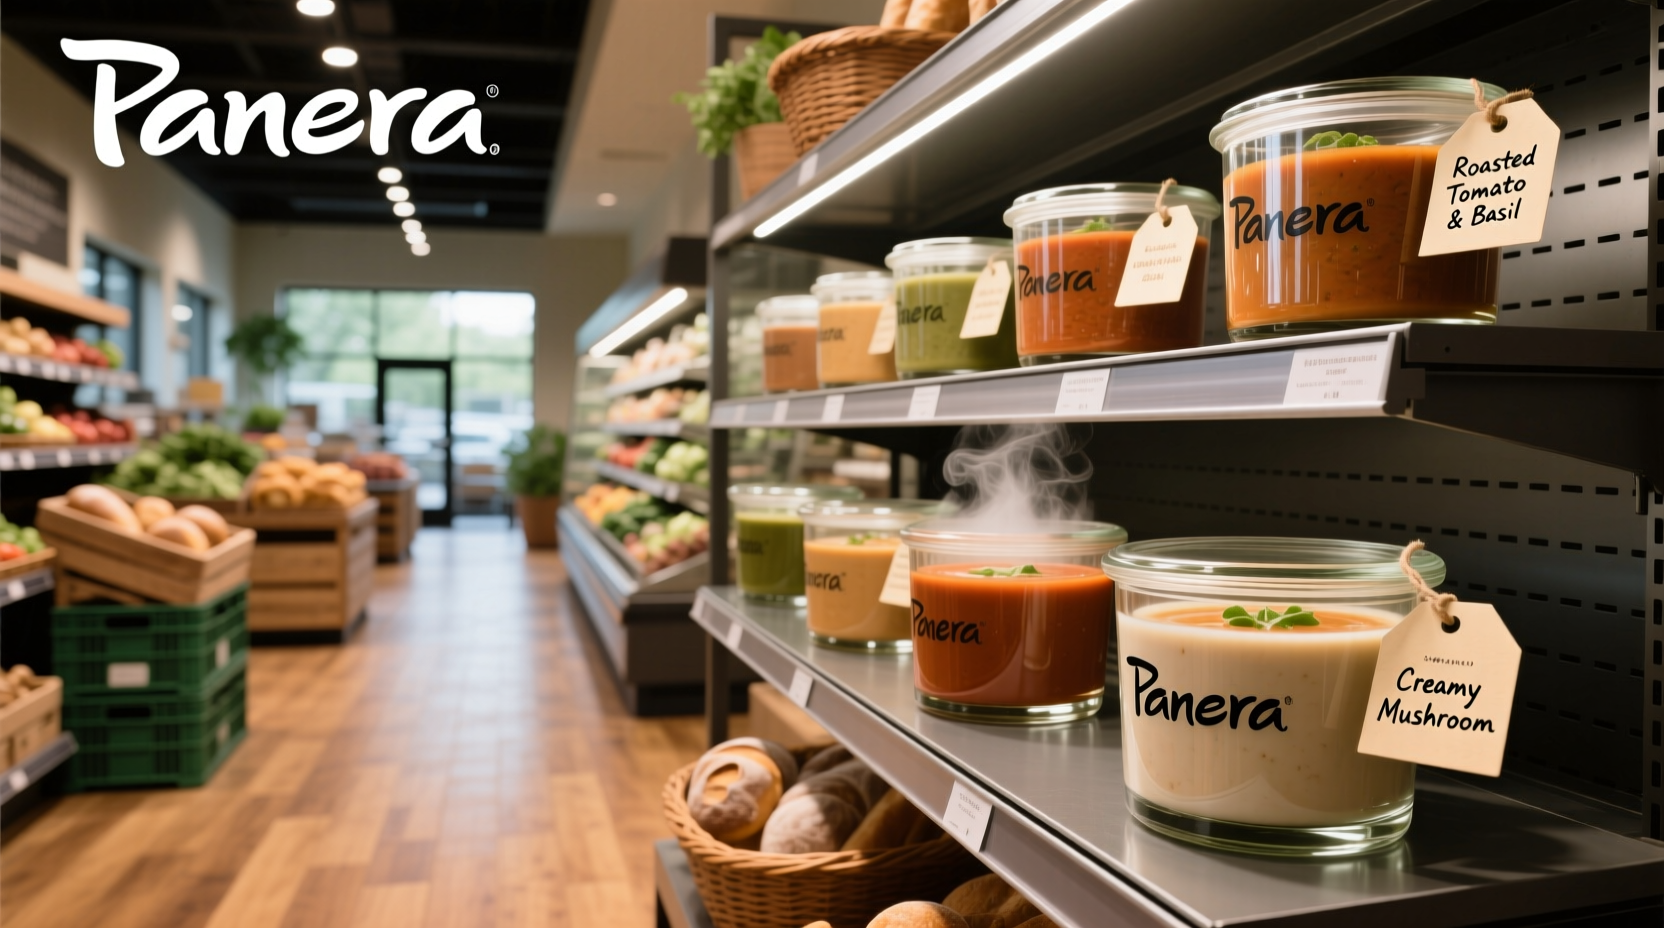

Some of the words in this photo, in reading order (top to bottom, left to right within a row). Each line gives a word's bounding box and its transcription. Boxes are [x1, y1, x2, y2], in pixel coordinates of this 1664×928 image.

[1453, 144, 1537, 178] Roasted
[1447, 175, 1526, 205] Tomato
[1230, 196, 1369, 249] Panera
[1447, 209, 1463, 229] &
[1471, 197, 1522, 226] Basil
[1127, 656, 1288, 732] Panera
[1397, 667, 1481, 709] Creamy
[1377, 698, 1495, 733] Mushroom
